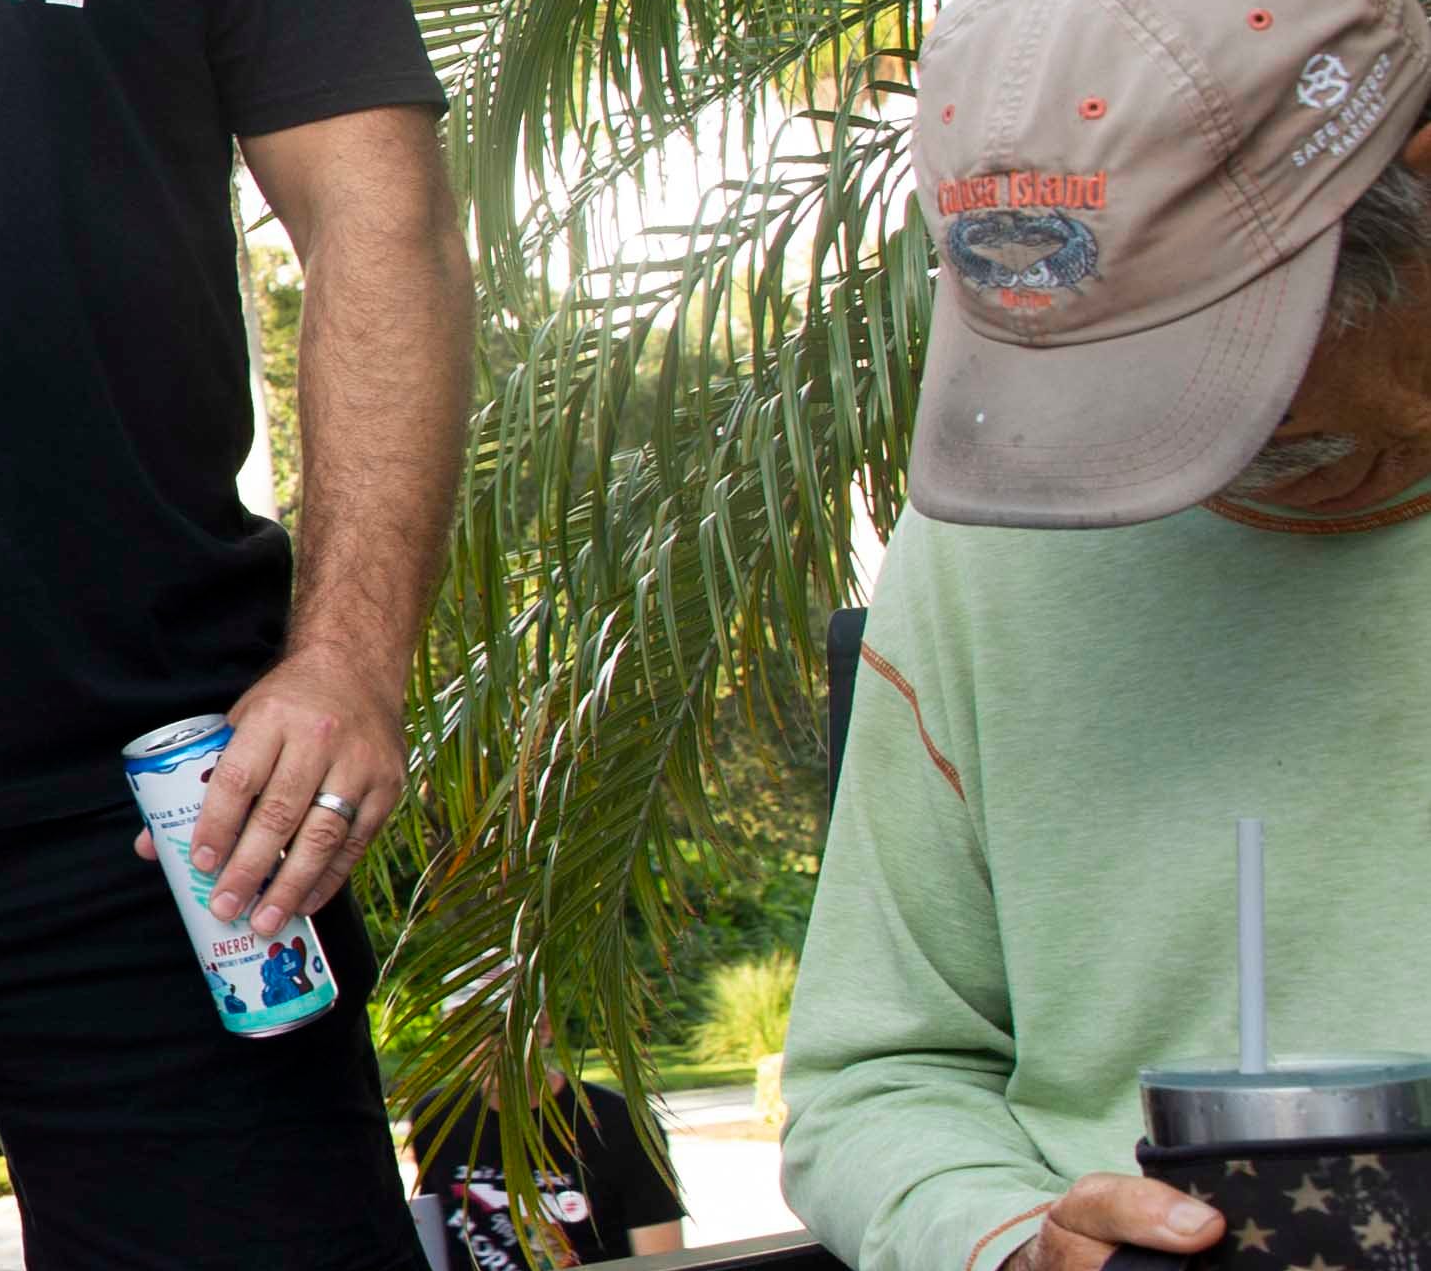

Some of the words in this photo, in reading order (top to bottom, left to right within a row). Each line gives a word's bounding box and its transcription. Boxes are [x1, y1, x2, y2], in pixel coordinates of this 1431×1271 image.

[1009, 169, 1106, 209] Island
[179, 802, 201, 815] SLU
[212, 934, 256, 957] ENERGY
